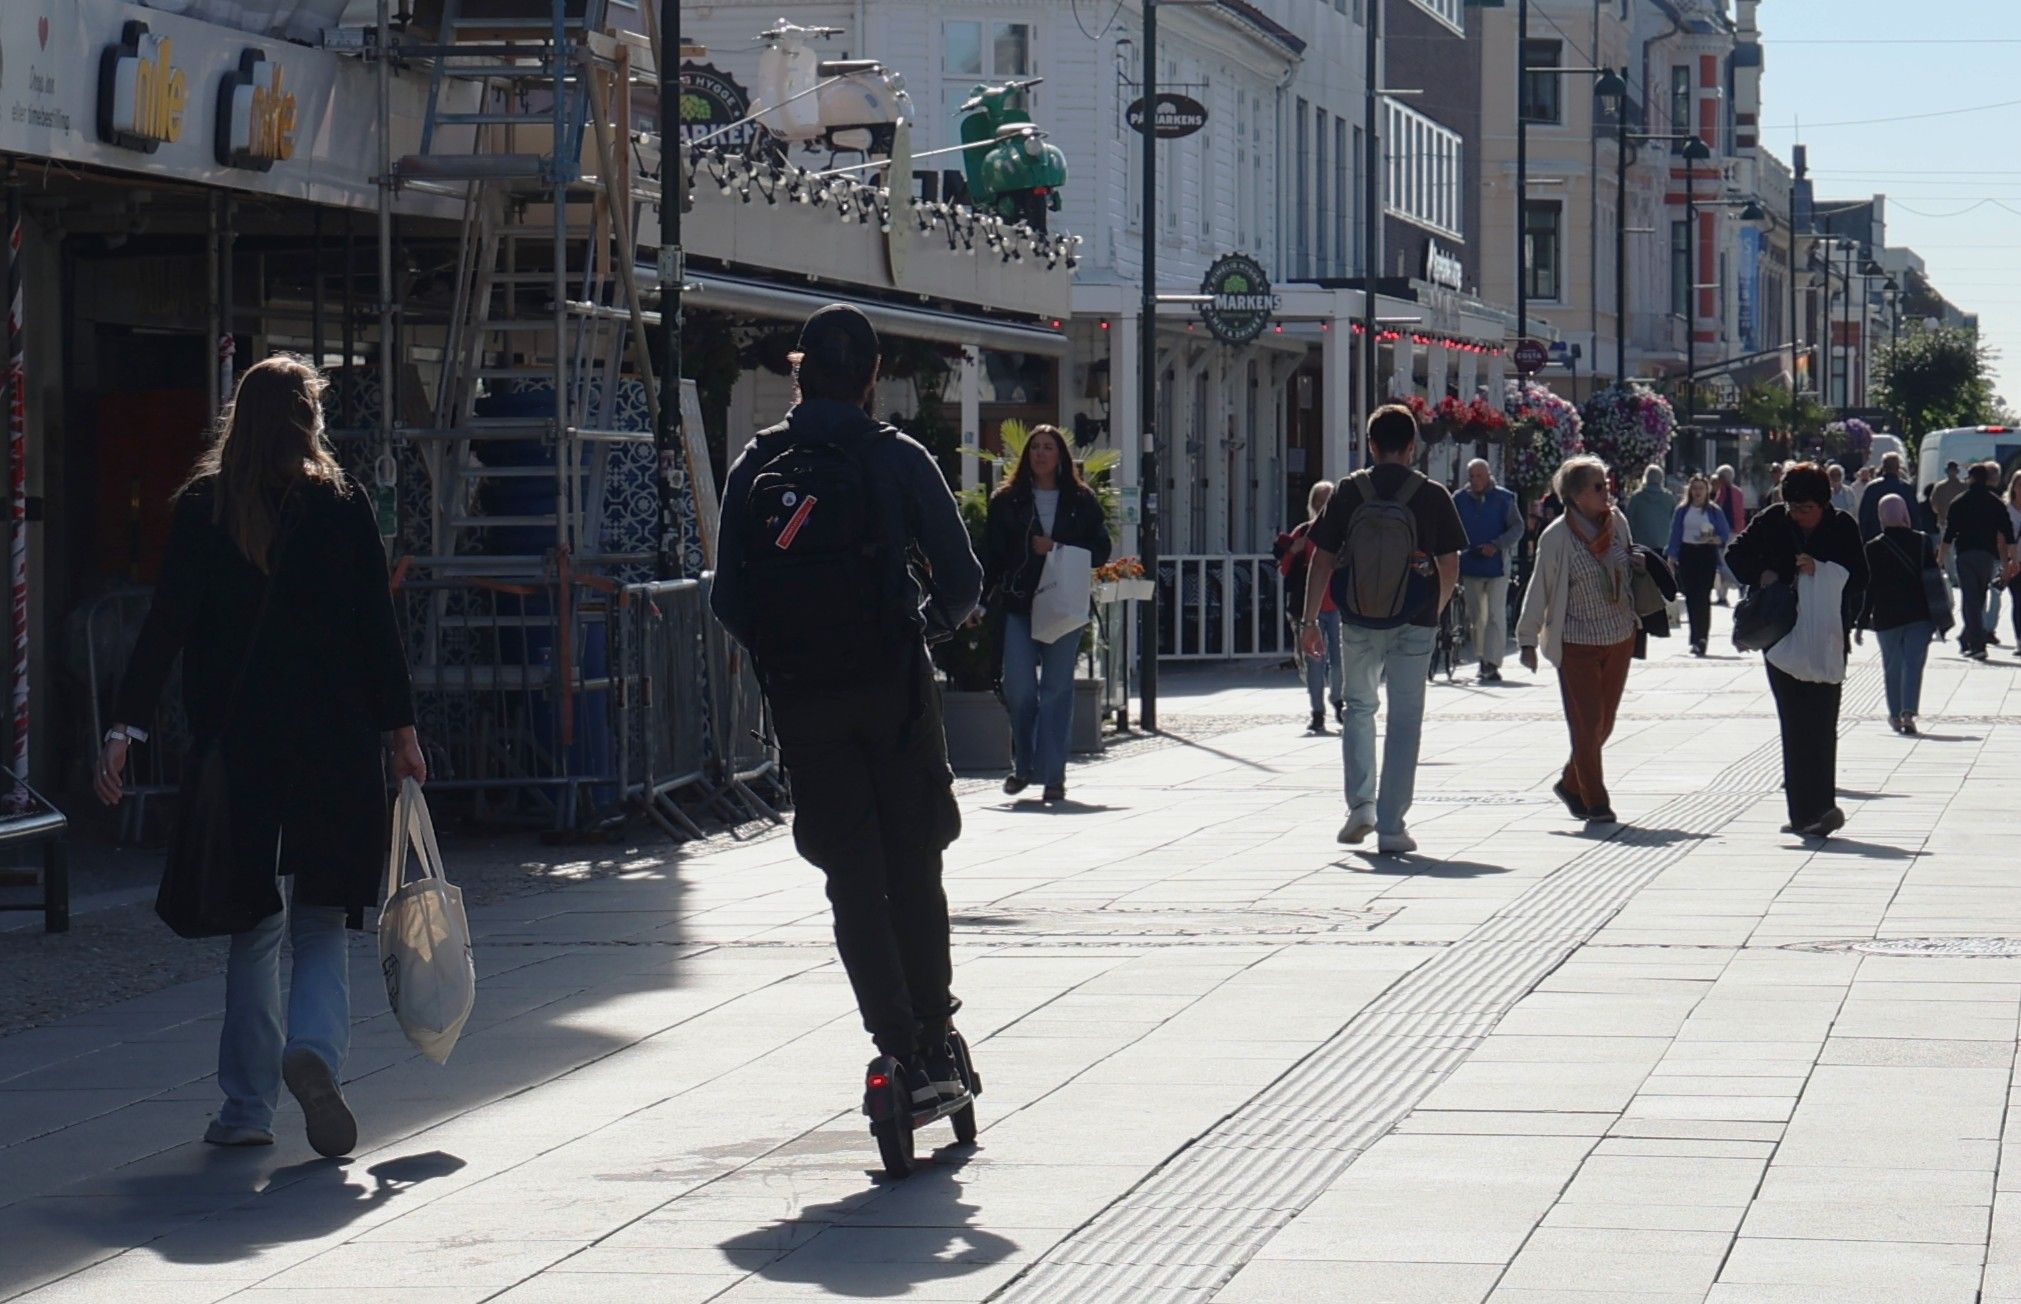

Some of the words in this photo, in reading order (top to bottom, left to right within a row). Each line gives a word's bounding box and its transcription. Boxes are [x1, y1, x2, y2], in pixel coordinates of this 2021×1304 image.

[695, 77, 736, 106] HYGGE
[1155, 114, 1202, 126] ARKENS
[1214, 294, 1282, 311] MARKENS
